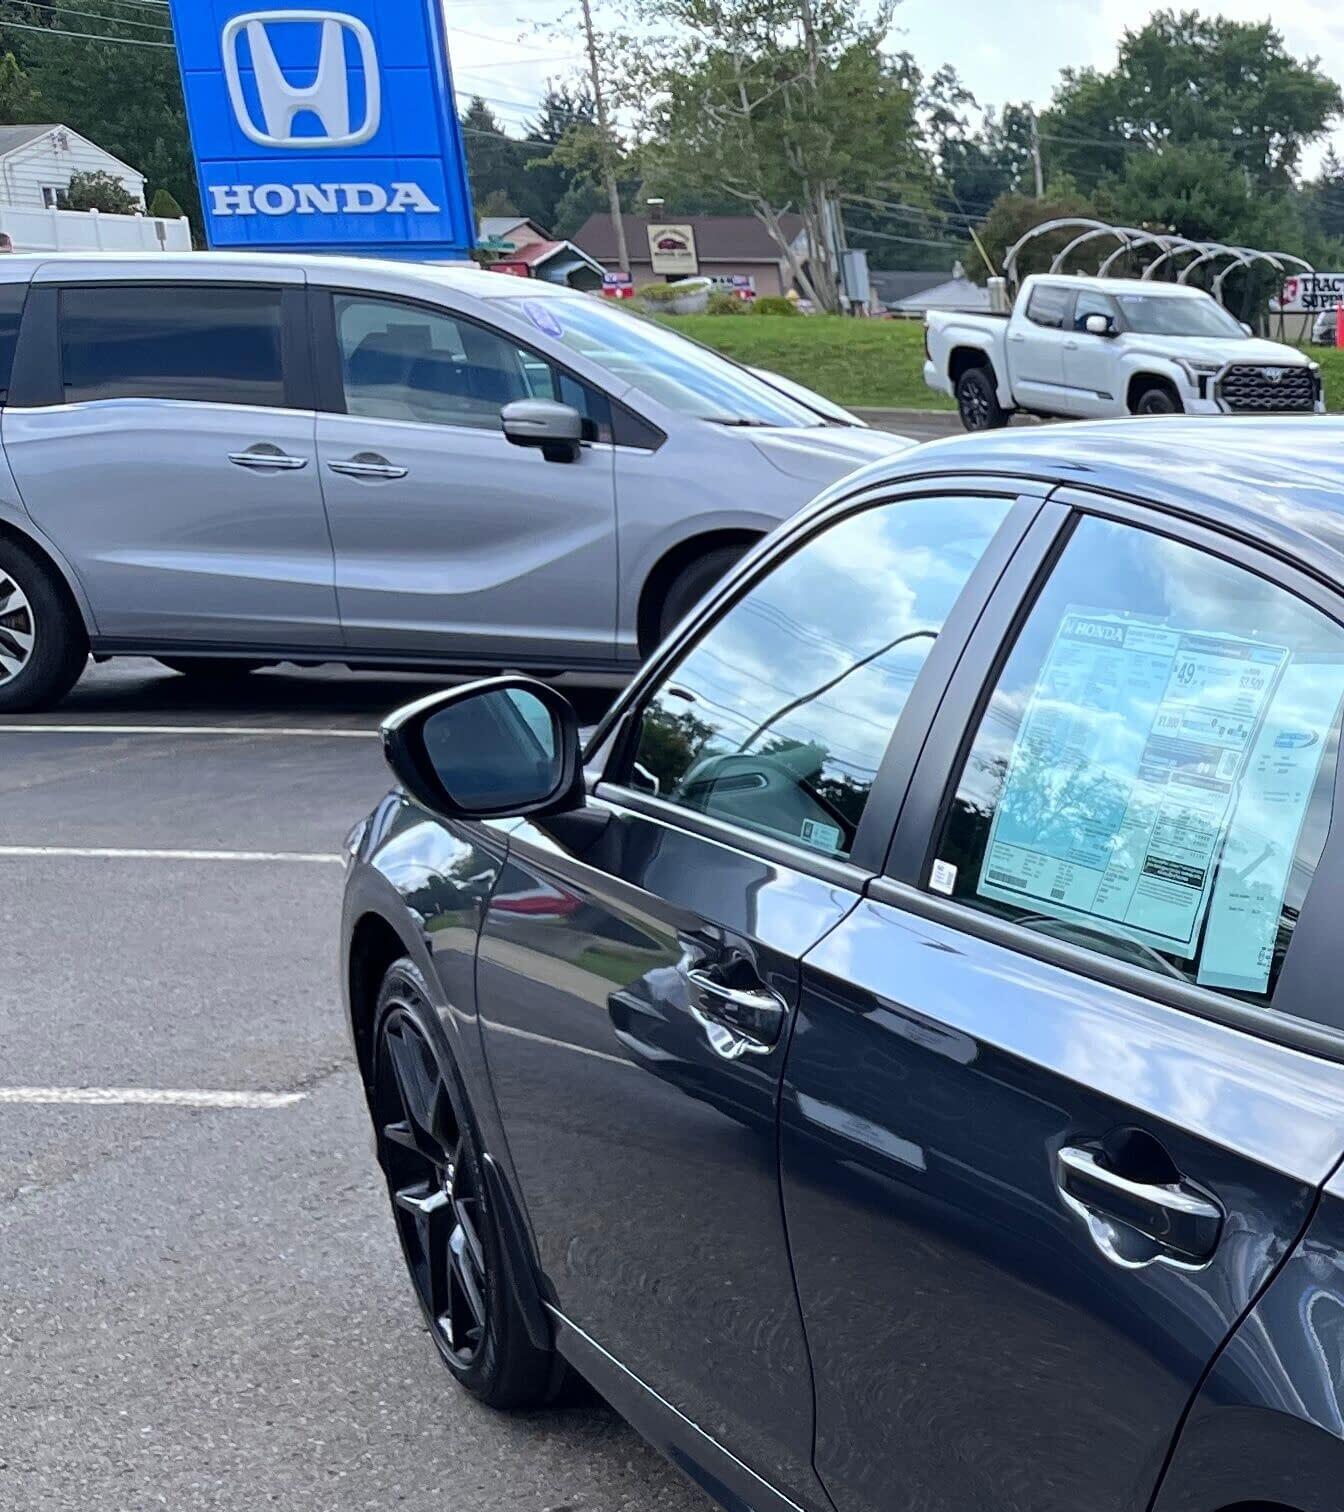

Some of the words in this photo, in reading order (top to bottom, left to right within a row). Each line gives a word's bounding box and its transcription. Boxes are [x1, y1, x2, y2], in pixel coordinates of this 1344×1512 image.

[208, 182, 441, 216] HONDA
[1074, 621, 1123, 641] HONDA
[1177, 661, 1196, 684] 49
